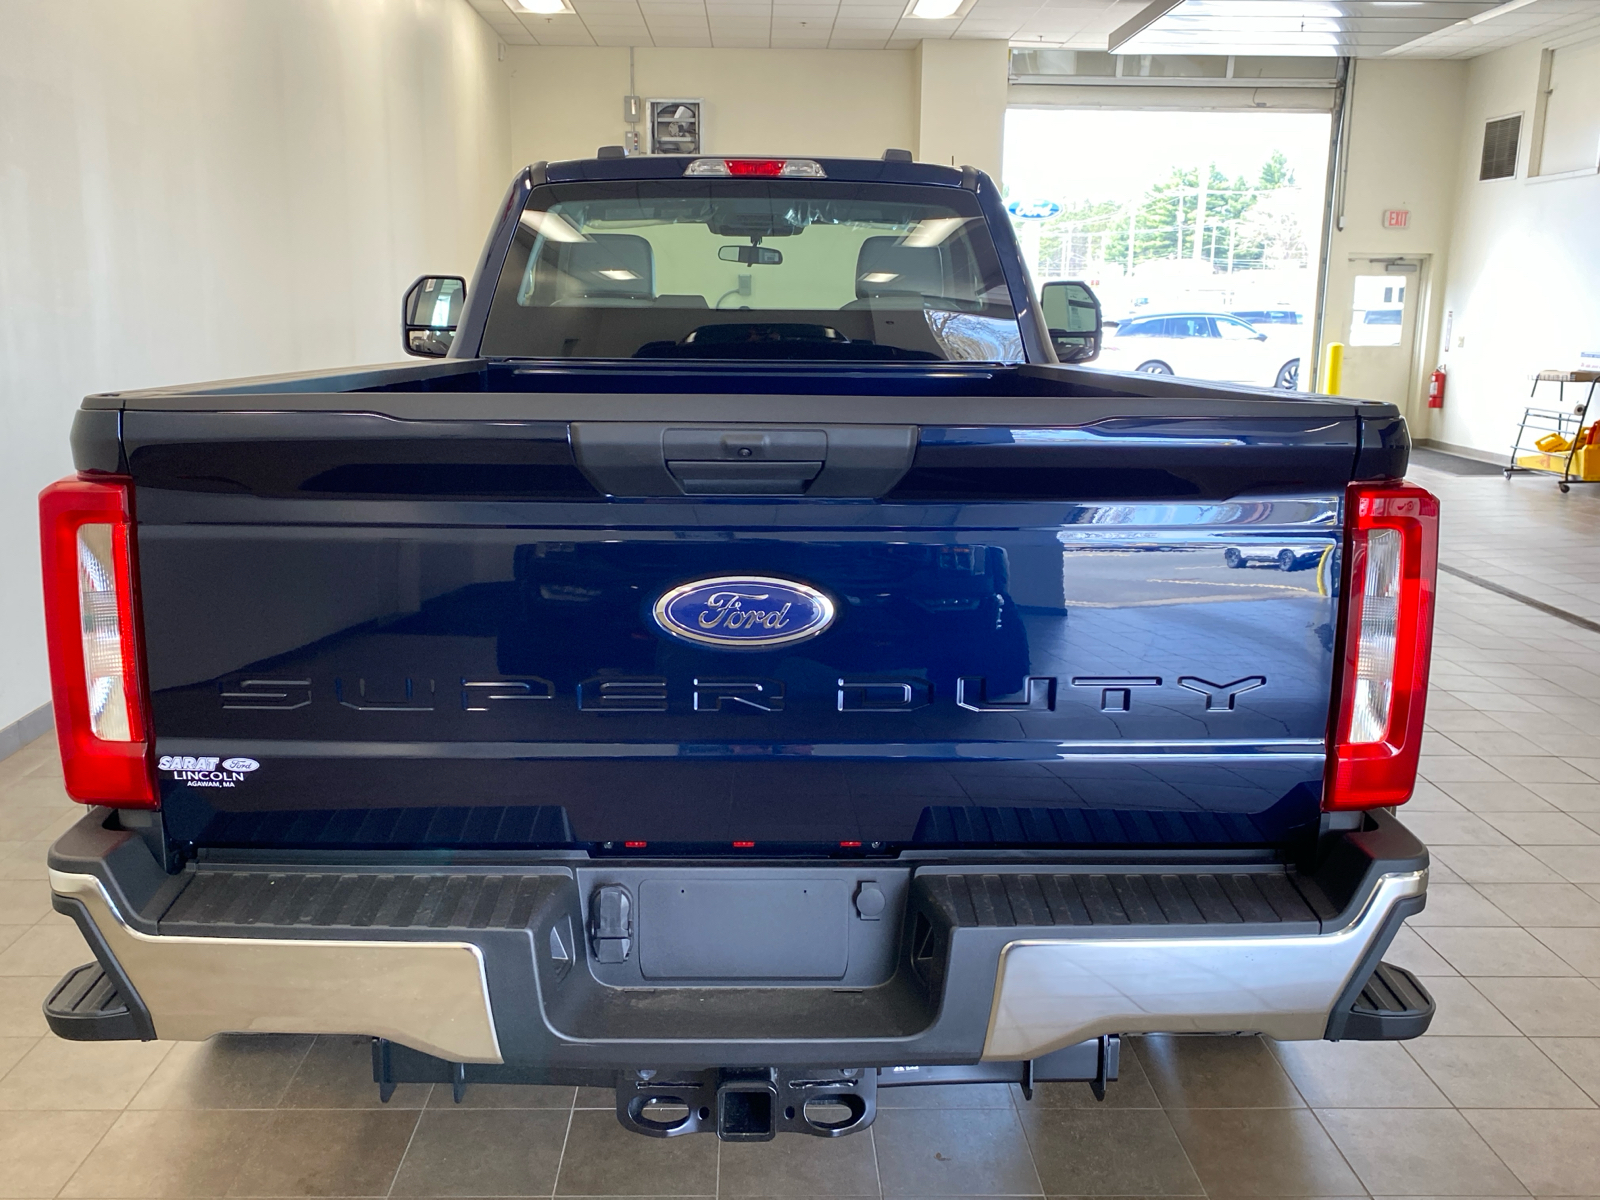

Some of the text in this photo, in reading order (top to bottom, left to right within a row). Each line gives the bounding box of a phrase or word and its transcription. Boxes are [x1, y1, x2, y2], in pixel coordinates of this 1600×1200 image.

[1388, 210, 1409, 227] EXIT
[699, 591, 791, 629] Ford
[219, 675, 1267, 712] SUPER DUTY
[158, 755, 220, 771] SARAT
[173, 770, 244, 781] LINCOLN
[186, 780, 222, 788] AGAWAM,
